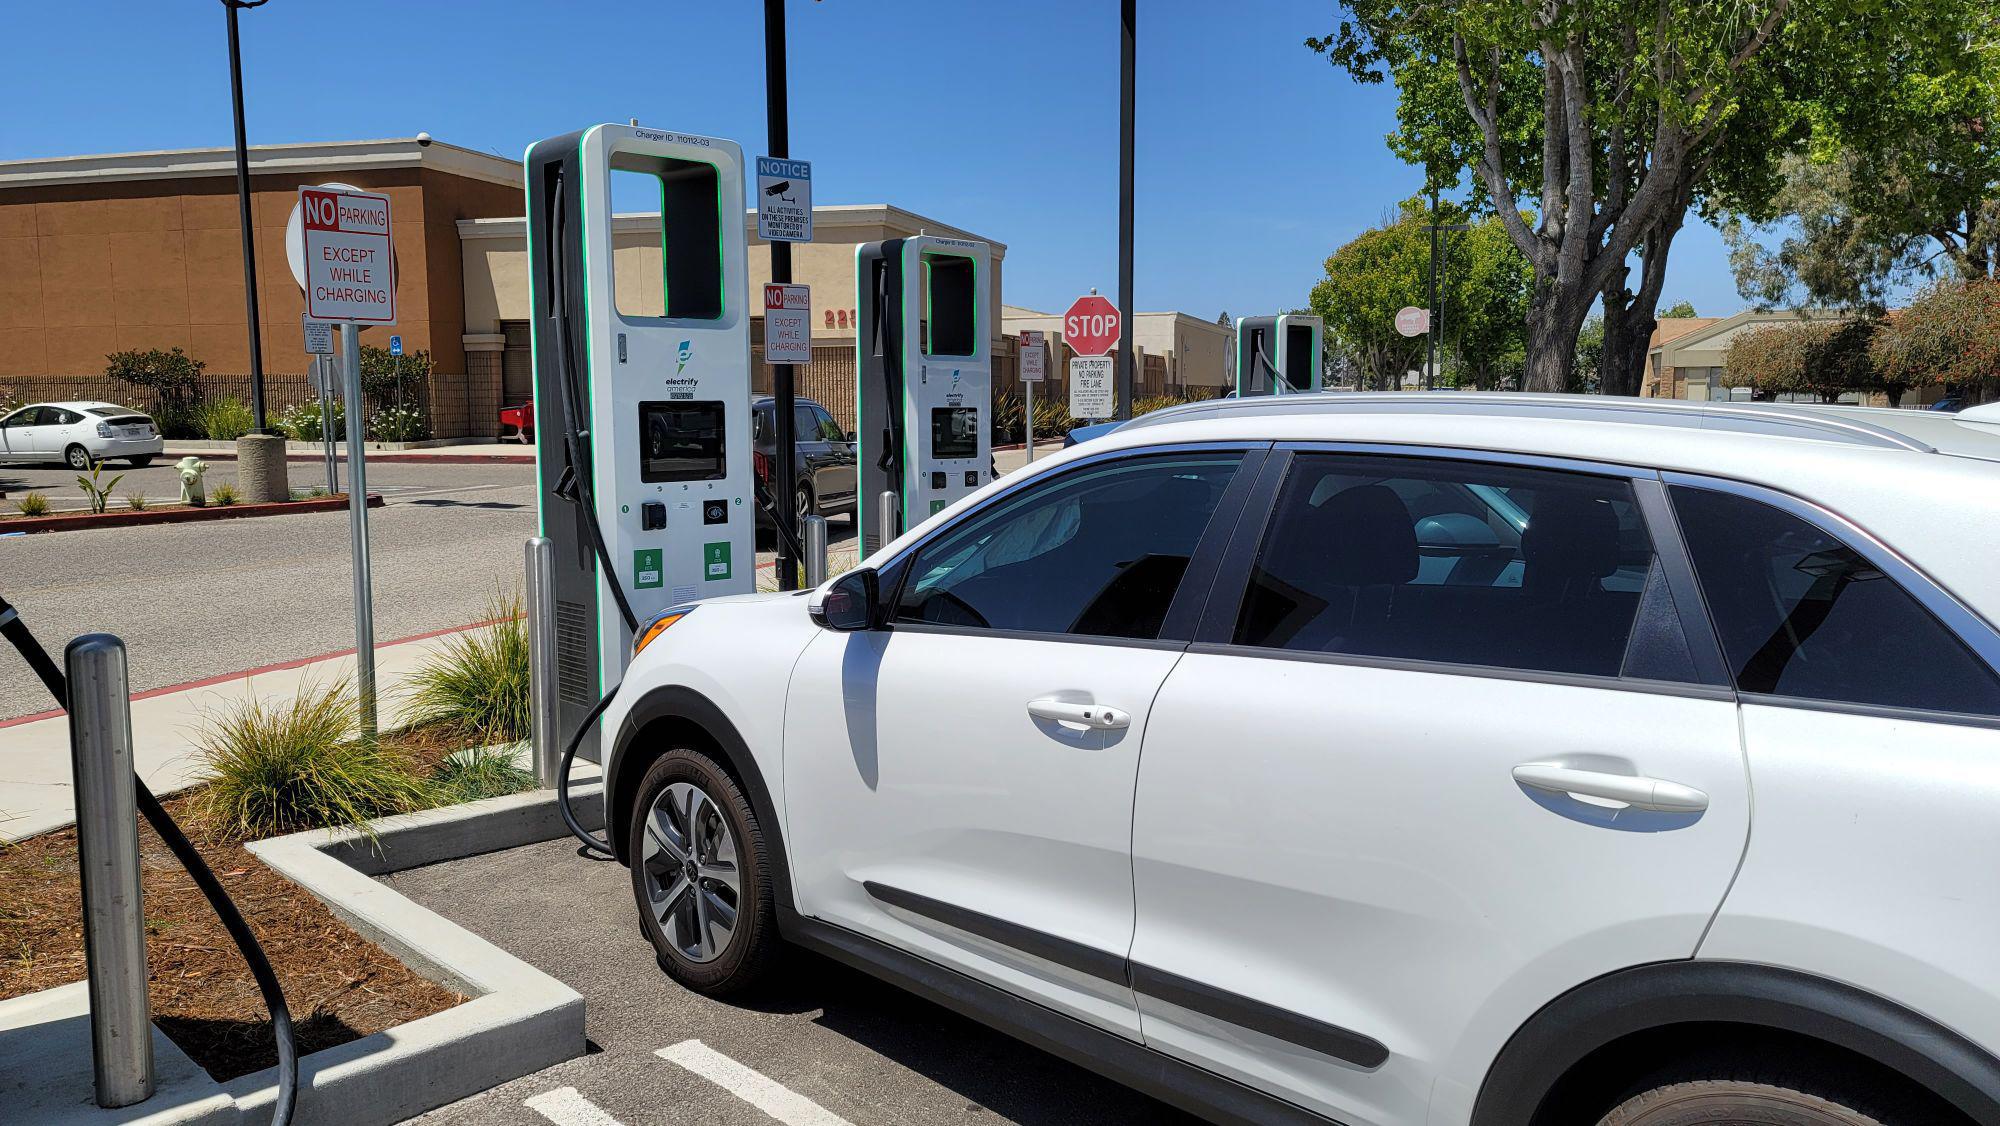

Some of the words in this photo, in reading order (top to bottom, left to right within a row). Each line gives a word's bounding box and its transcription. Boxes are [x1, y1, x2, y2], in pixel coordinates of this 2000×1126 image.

[635, 130, 664, 141] Charger
[666, 134, 674, 142] ID
[677, 135, 710, 147] 110112-03
[760, 161, 808, 177] NOTICE
[305, 196, 336, 226] NO
[339, 206, 386, 227] PARKING
[768, 205, 776, 213] ALL
[777, 206, 803, 215] ACTIVITIES
[762, 213, 768, 221] ON
[769, 214, 783, 222] THESE
[785, 215, 808, 224] PREMISES
[768, 221, 795, 230] MONITORED
[796, 223, 802, 231] BY
[768, 228, 782, 237] VIDEO
[783, 229, 803, 238] CAMERA
[323, 246, 375, 263] EXCEPT
[329, 267, 371, 284] WHILE
[317, 286, 386, 304] CHARGING
[767, 289, 782, 306] NO
[784, 294, 807, 304] PARKING
[774, 318, 801, 328] EXCEPT
[1067, 314, 1117, 338] STOP
[778, 330, 799, 340] WHILE
[770, 342, 806, 352] CHARGING
[1072, 360, 1088, 369] PRIVATE
[1089, 360, 1111, 369] PROPERTY
[1079, 370, 1085, 378] NO
[1086, 370, 1104, 379] PARKING
[665, 377, 698, 386] electrify
[1081, 379, 1089, 388] FIRE
[1091, 379, 1102, 388] LANE
